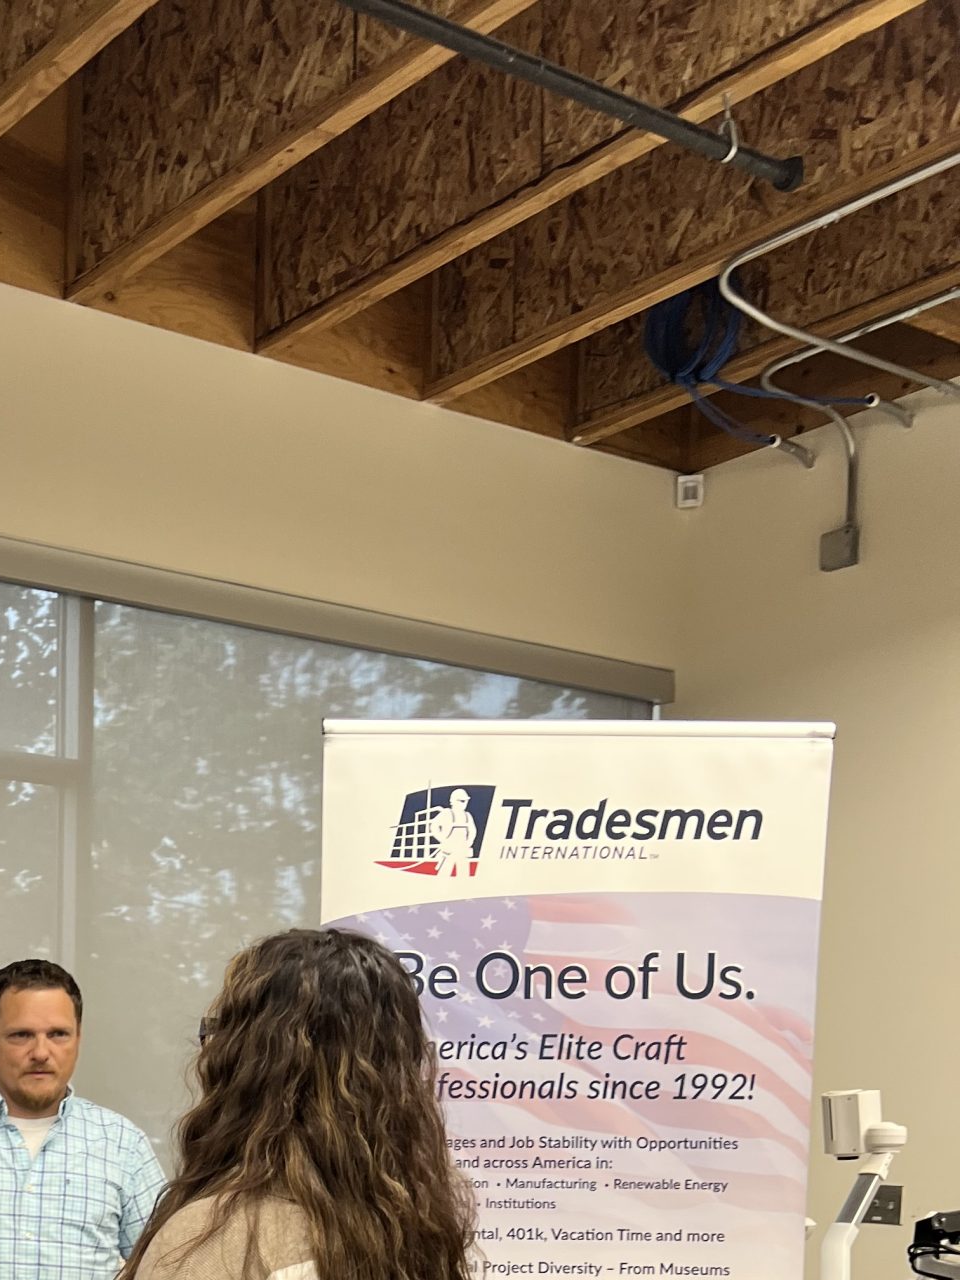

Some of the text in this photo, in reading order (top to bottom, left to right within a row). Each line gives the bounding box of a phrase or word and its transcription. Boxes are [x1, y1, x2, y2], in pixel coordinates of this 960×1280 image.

[501, 798, 763, 841] Tradesmen
[476, 952, 587, 999] One
[605, 952, 658, 999] of
[676, 952, 755, 999] Us.
[427, 1033, 687, 1061] erica’s Elite Craft
[437, 1072, 756, 1100] fessionals since 1992!
[447, 1136, 738, 1153] ages and Job Stability with Opportunities
[456, 1156, 613, 1169] and across America in:
[506, 1178, 728, 1195] Manufacturing Renewable Energy
[485, 1197, 556, 1209] Institutions
[466, 1228, 725, 1243] ntal, 401k, Vacation Time and more
[483, 1261, 533, 1276] Project
[538, 1262, 602, 1276] Diversity
[619, 1262, 655, 1275] From
[660, 1263, 730, 1276] Museums
